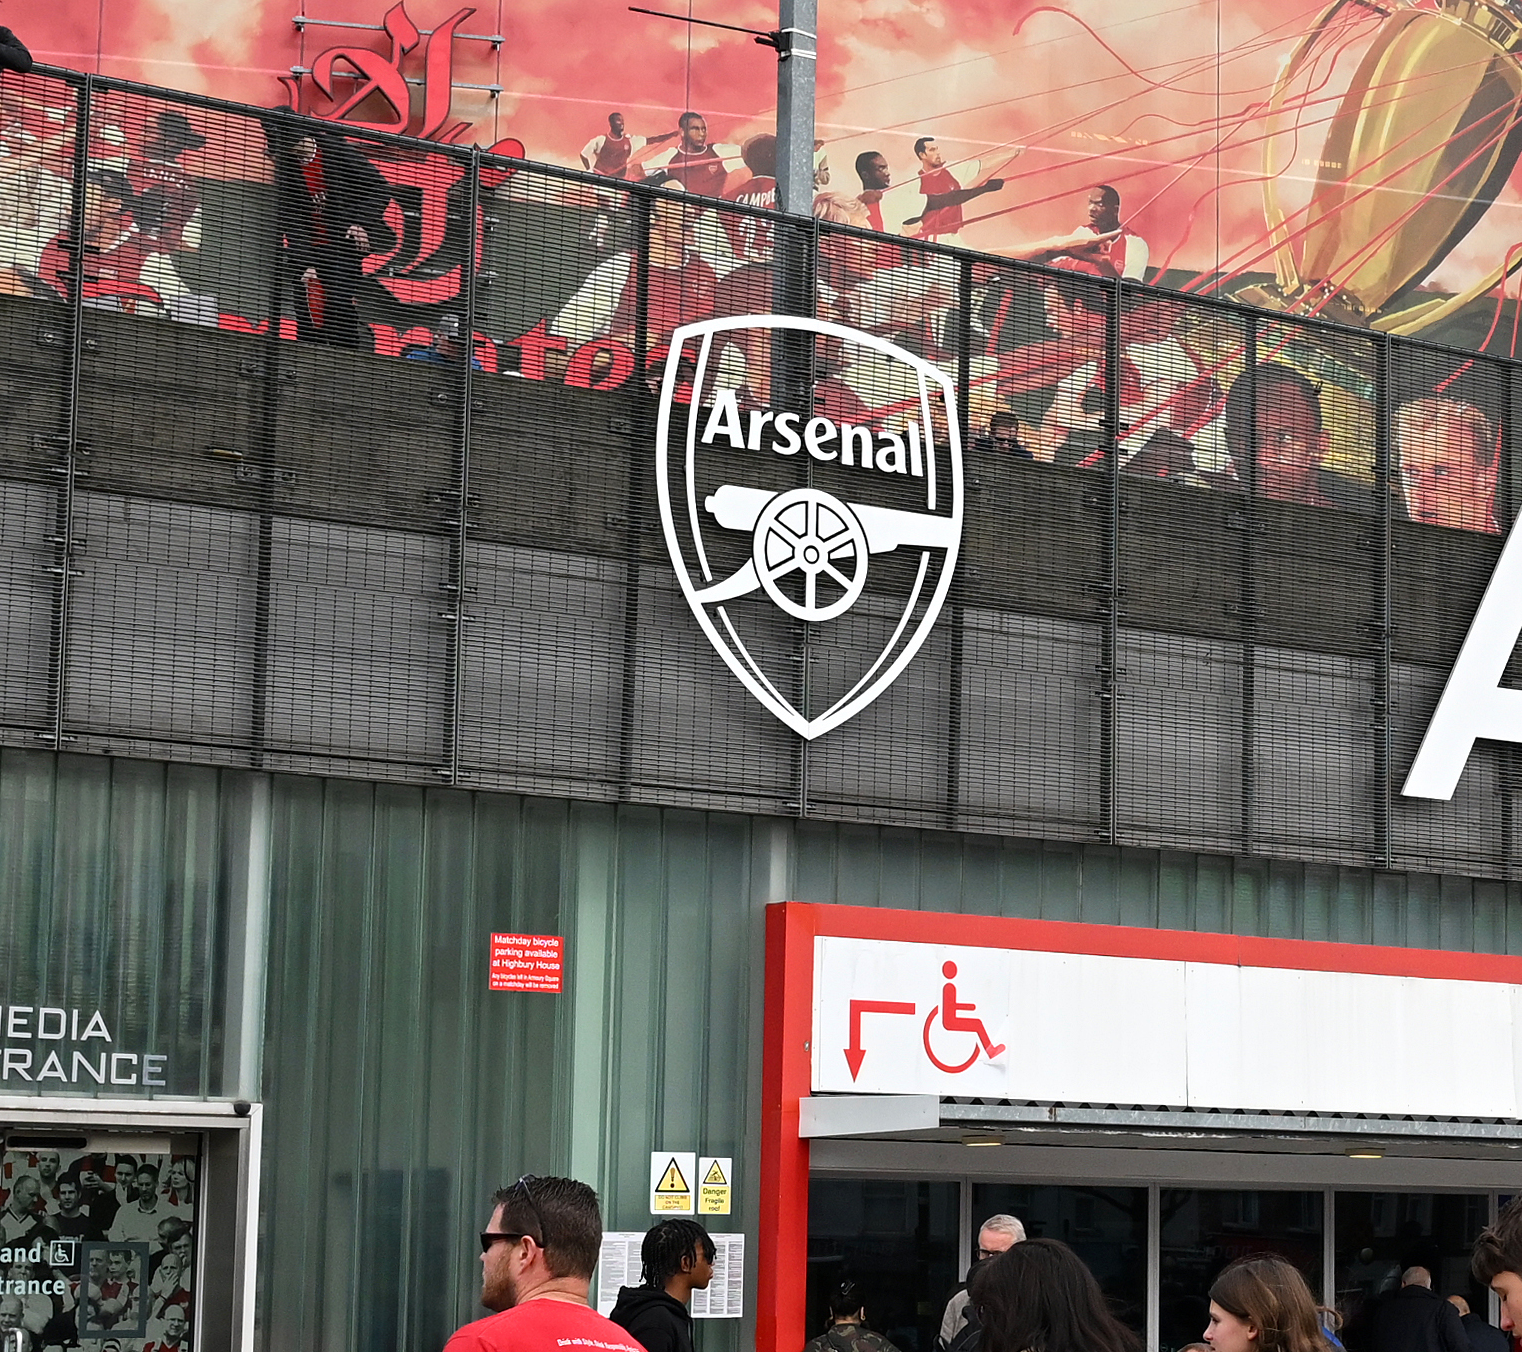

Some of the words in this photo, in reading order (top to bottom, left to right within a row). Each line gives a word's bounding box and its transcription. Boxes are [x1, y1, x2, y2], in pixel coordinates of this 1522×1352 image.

[703, 389, 923, 476] Arsenal
[494, 935, 532, 947] Matchday
[532, 937, 559, 948] bicycle
[495, 948, 524, 958] parking
[524, 949, 558, 958] available
[492, 959, 500, 967] at
[501, 959, 535, 970] Highbury
[536, 961, 560, 970] House
[702, 1188, 727, 1196] Danger
[0, 1242, 42, 1263] and
